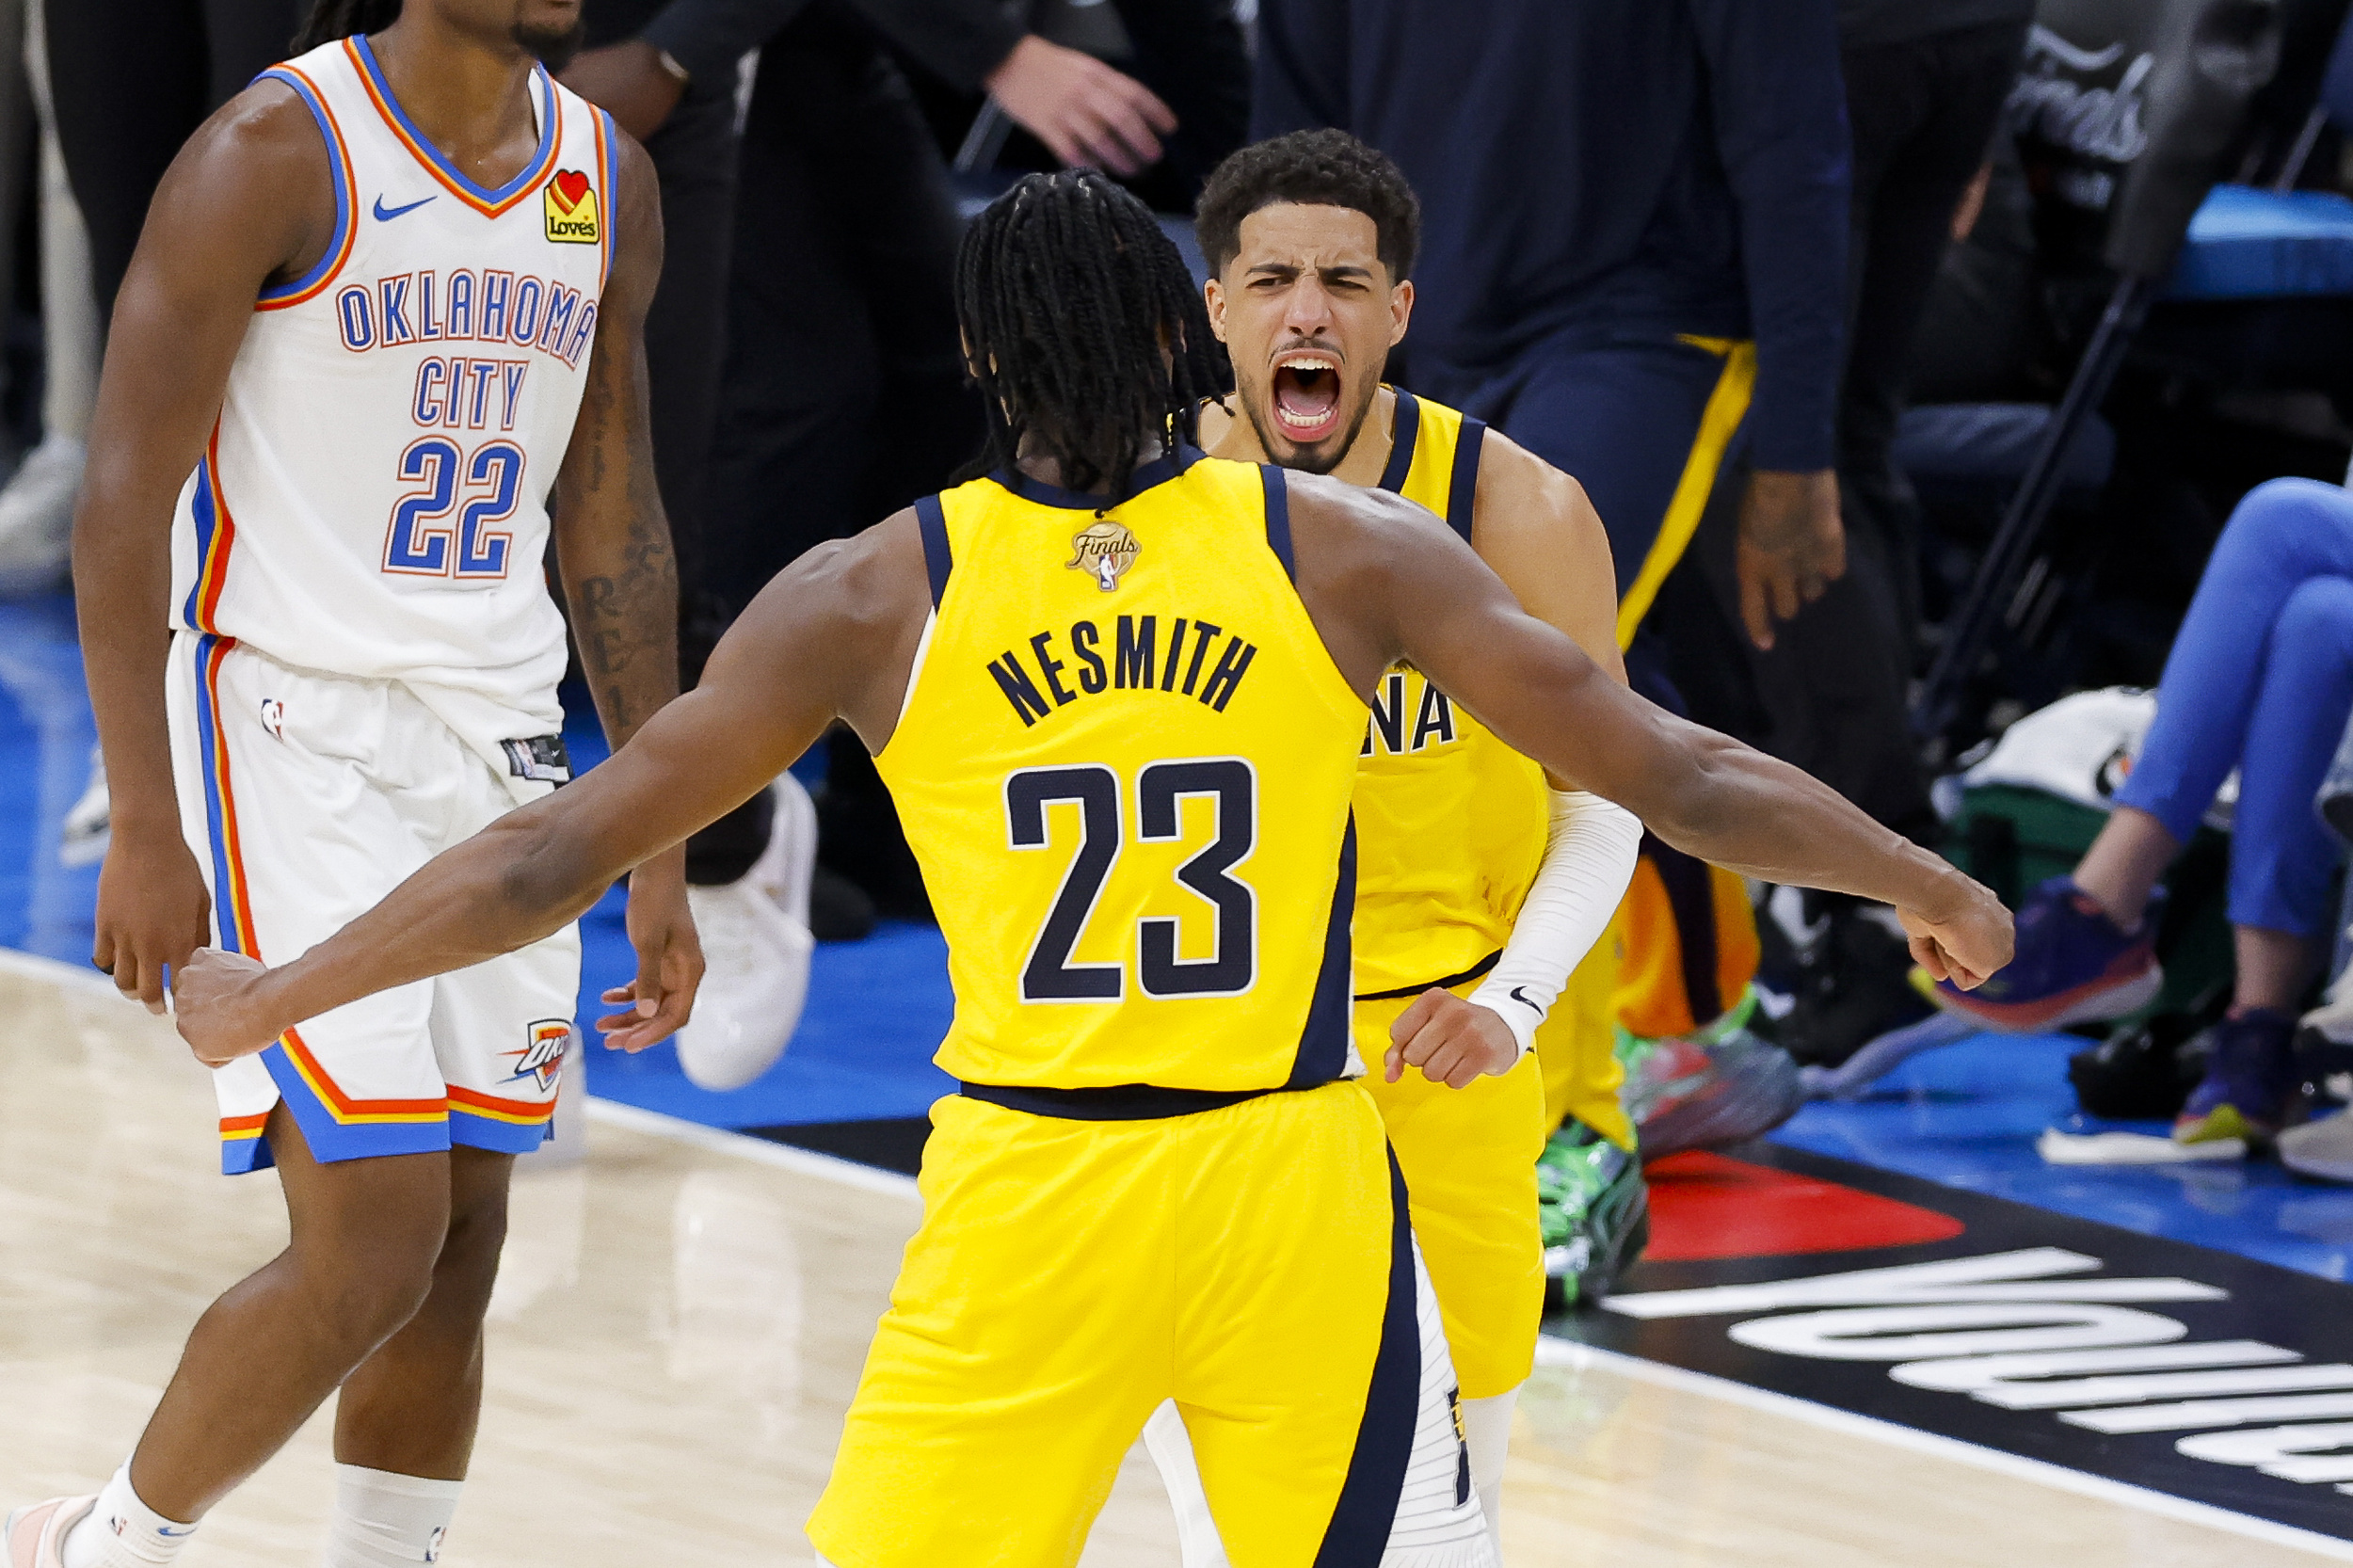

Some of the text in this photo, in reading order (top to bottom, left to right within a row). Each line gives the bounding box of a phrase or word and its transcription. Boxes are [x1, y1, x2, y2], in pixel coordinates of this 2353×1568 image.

[335, 267, 599, 372] OKLAHOMA
[410, 356, 531, 431] CITY
[381, 434, 526, 580] 22
[1068, 531, 1133, 567] Finals
[986, 615, 1257, 728] NESMITH
[1004, 756, 1257, 1003] 23
